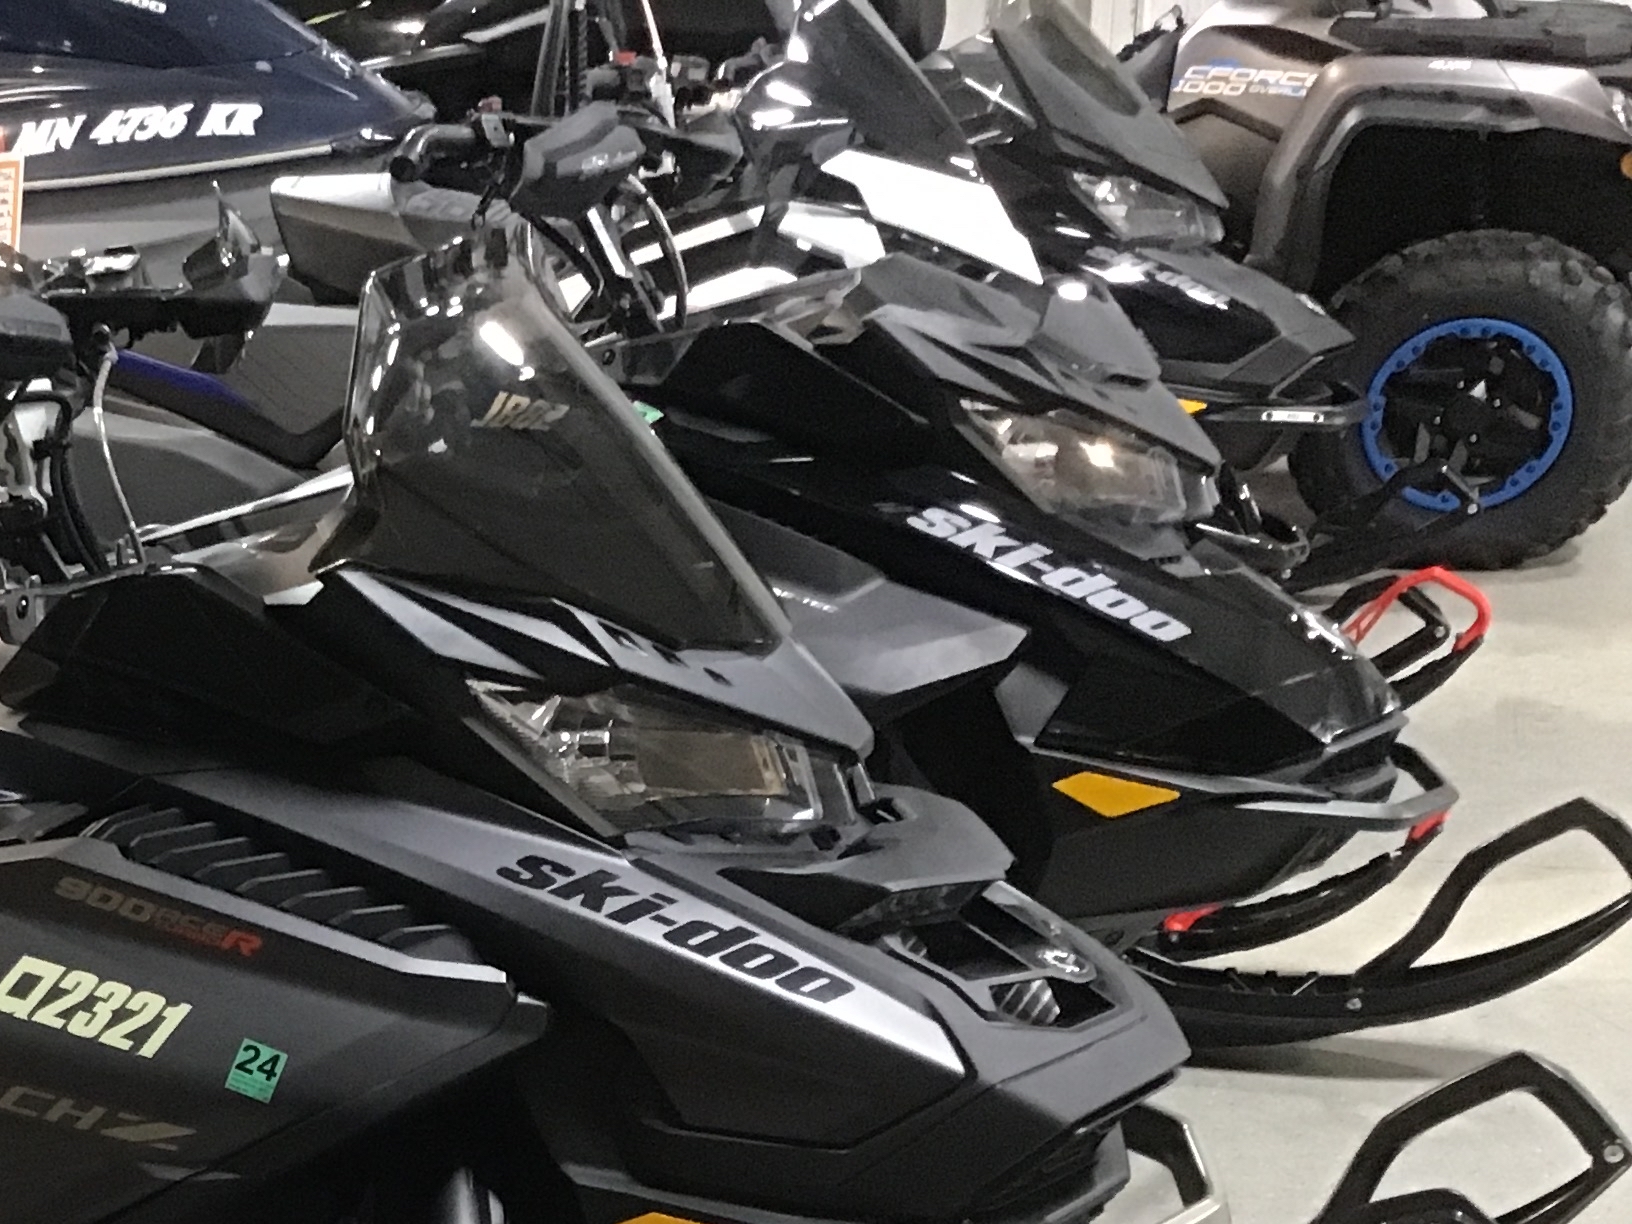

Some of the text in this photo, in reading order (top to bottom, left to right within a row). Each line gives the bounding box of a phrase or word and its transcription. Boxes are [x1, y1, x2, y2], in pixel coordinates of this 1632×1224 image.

[12, 103, 264, 156] MN 4736 KR
[906, 507, 1192, 642] ski-doo
[496, 854, 857, 1003] ski-doo
[234, 1044, 279, 1082] 24
